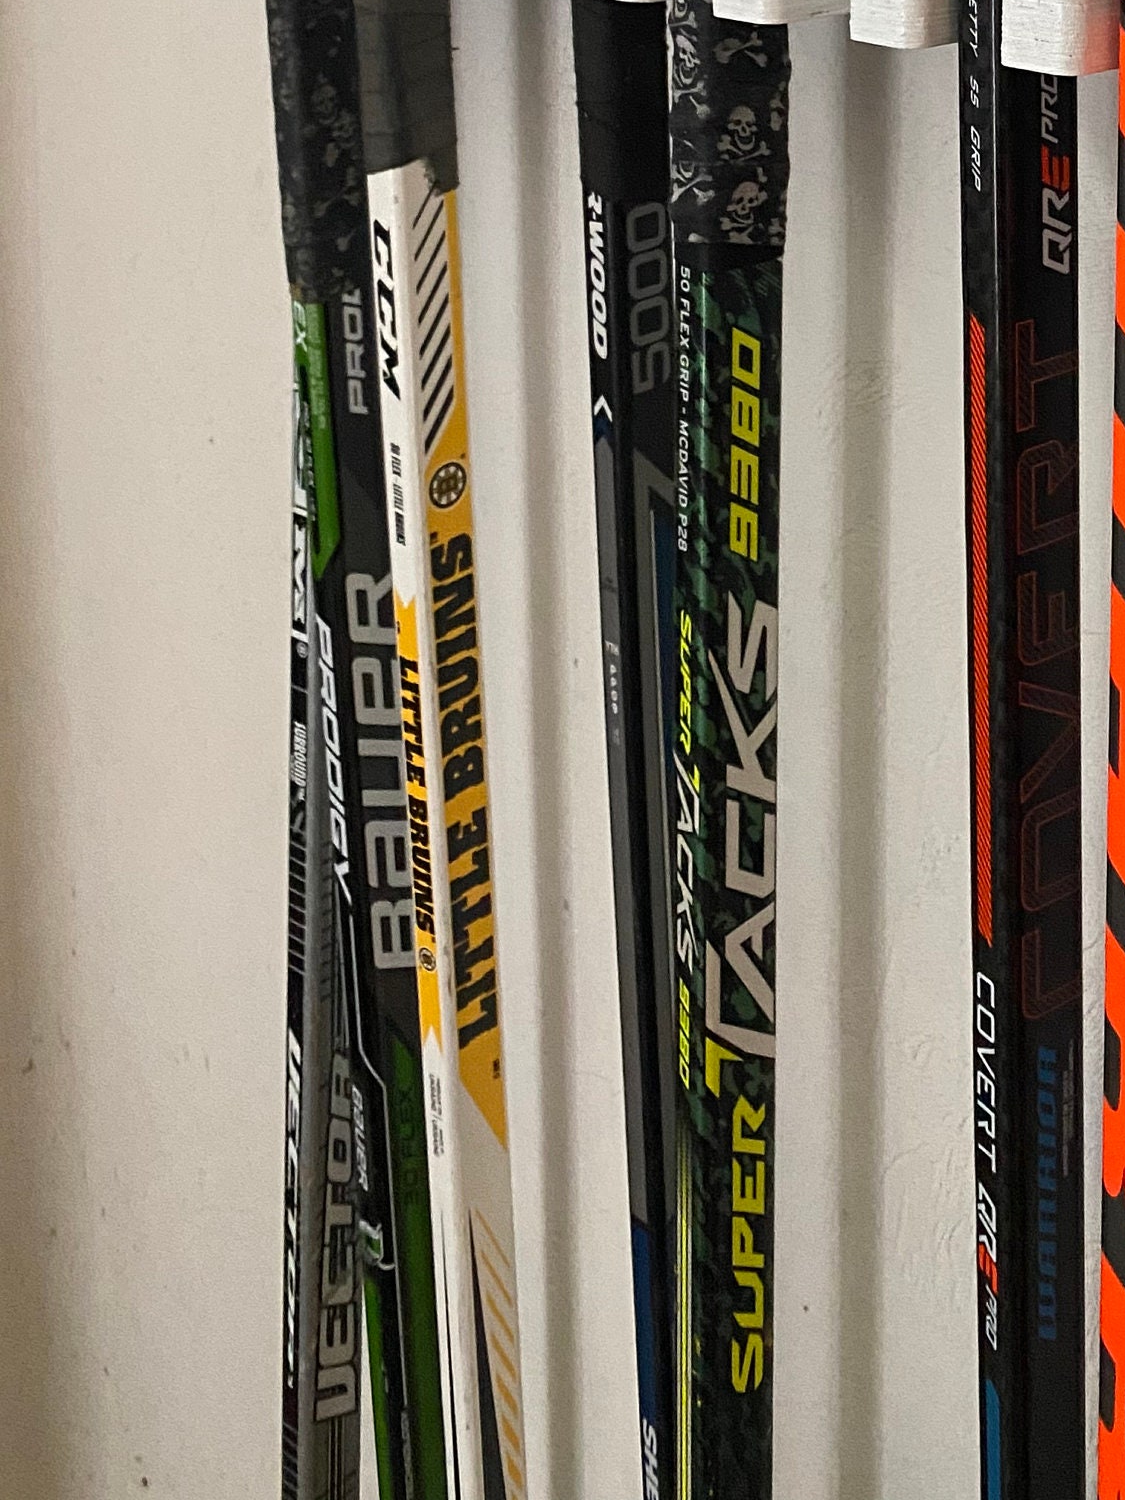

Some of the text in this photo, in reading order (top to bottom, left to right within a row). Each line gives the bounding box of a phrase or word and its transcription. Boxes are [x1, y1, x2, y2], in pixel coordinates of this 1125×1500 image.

[970, 125, 982, 192] GRIP
[1040, 146, 1073, 275] QRE
[374, 218, 401, 402] CCM
[626, 201, 672, 395] 5000
[680, 265, 691, 292] 50
[680, 297, 691, 349] FLEX
[678, 419, 690, 509] MCDAVID
[679, 354, 690, 402] GRIP
[729, 327, 762, 563] 9380
[677, 513, 688, 552] P28
[316, 613, 352, 906] PRODIGY
[679, 609, 692, 757] SUPER
[1014, 319, 1082, 1020] COVERT
[400, 655, 437, 937] LITTLE BRUINS
[430, 533, 499, 1051] LITTLE BRUINS
[672, 750, 700, 976] TACKS
[704, 590, 778, 1394] SUPER TACKS
[975, 971, 997, 1175] COVERT
[314, 1053, 357, 1422] VECTOR
[977, 1181, 998, 1294] QRE
